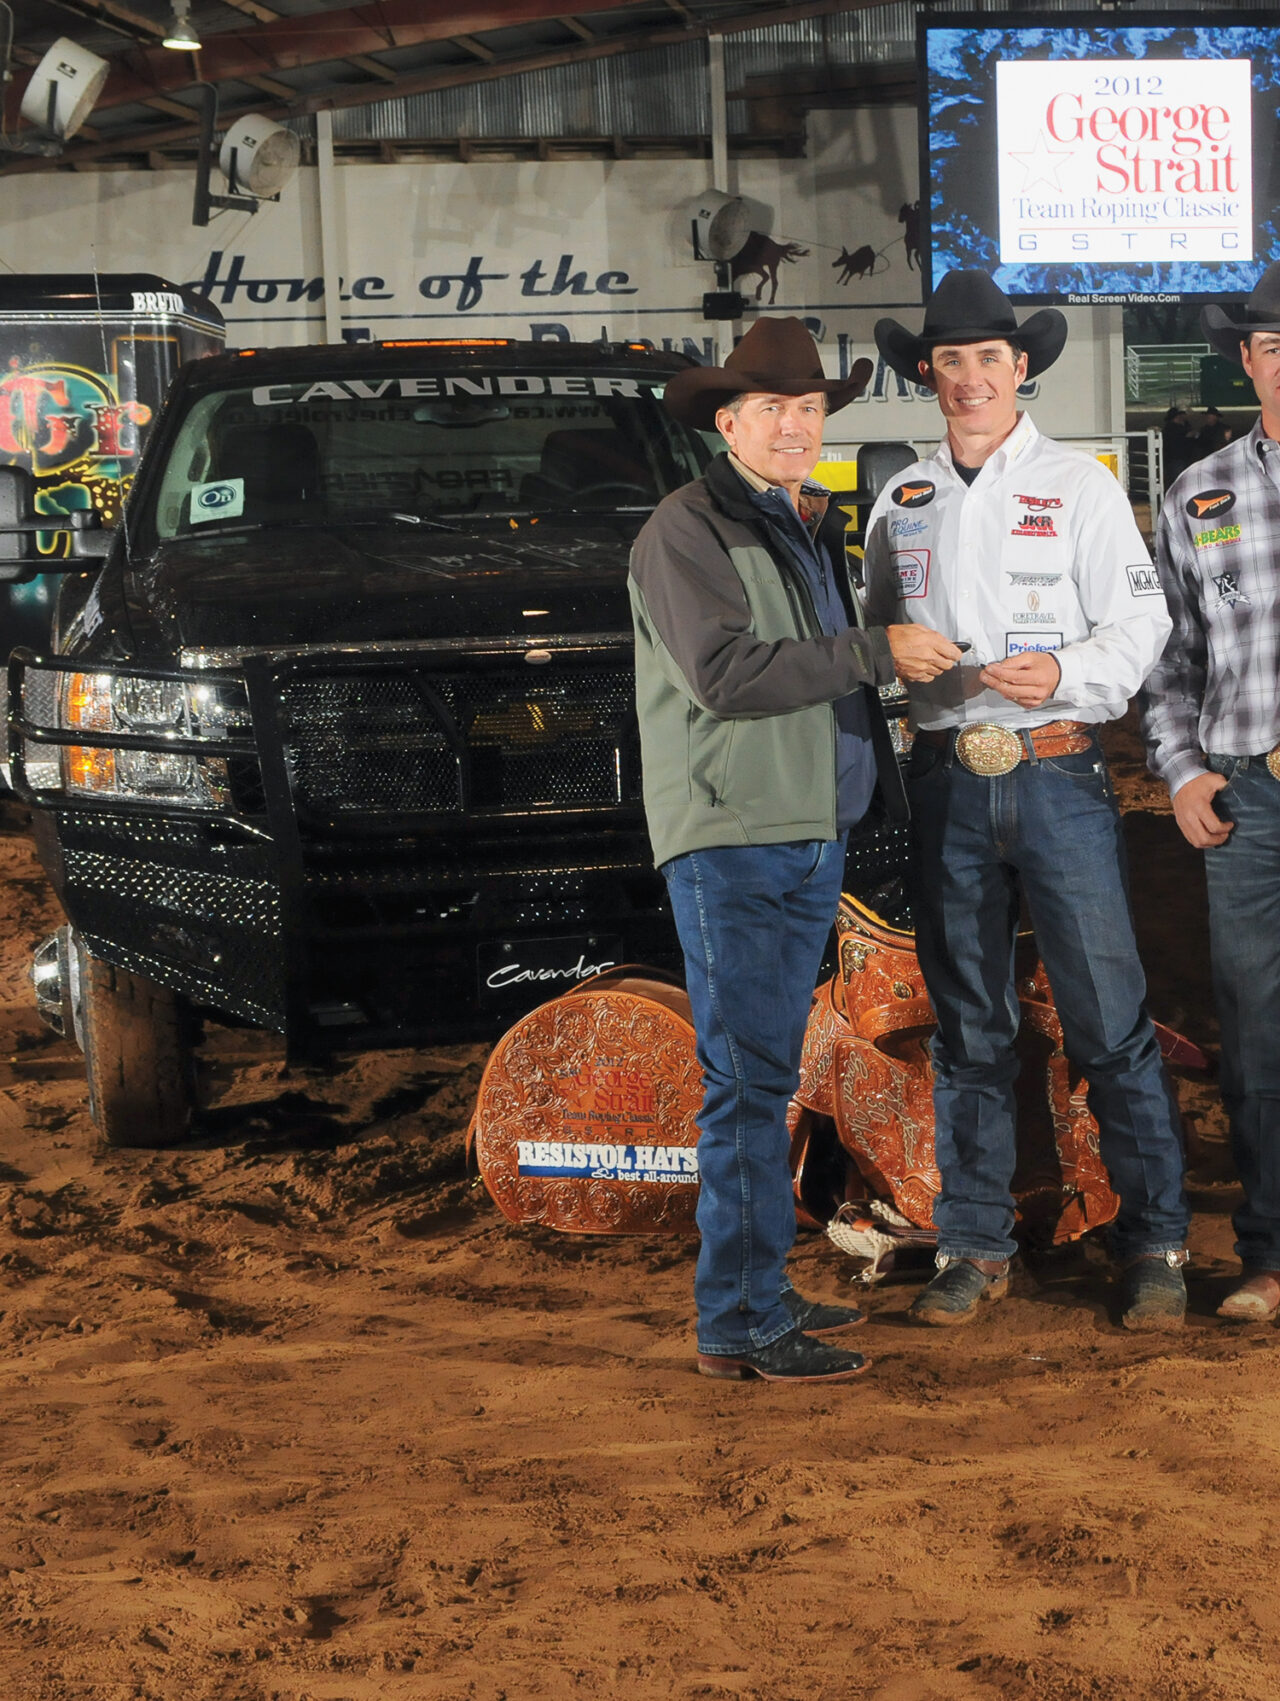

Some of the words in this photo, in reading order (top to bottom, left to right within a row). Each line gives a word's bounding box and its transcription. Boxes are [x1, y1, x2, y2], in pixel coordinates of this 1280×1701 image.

[1094, 76, 1163, 96] 2012
[1046, 92, 1230, 155] George
[1096, 144, 1240, 194] Strait
[1012, 197, 1075, 220] Team
[1081, 198, 1160, 224] Roping
[1163, 196, 1239, 218] Classic
[180, 250, 394, 304] Home
[419, 256, 509, 311] of
[520, 254, 639, 296] the
[1068, 294, 1090, 304] Real
[1091, 293, 1126, 304] Screen
[1127, 293, 1180, 303] Video.Com
[252, 376, 643, 406] CAVENDER
[487, 955, 615, 988] Cavender
[575, 1061, 652, 1094] George
[594, 1087, 655, 1112] Strait
[517, 1141, 632, 1169] RESISTOL
[633, 1145, 699, 1173] HATS
[617, 1169, 641, 1181] best
[643, 1170, 699, 1184] all-around
